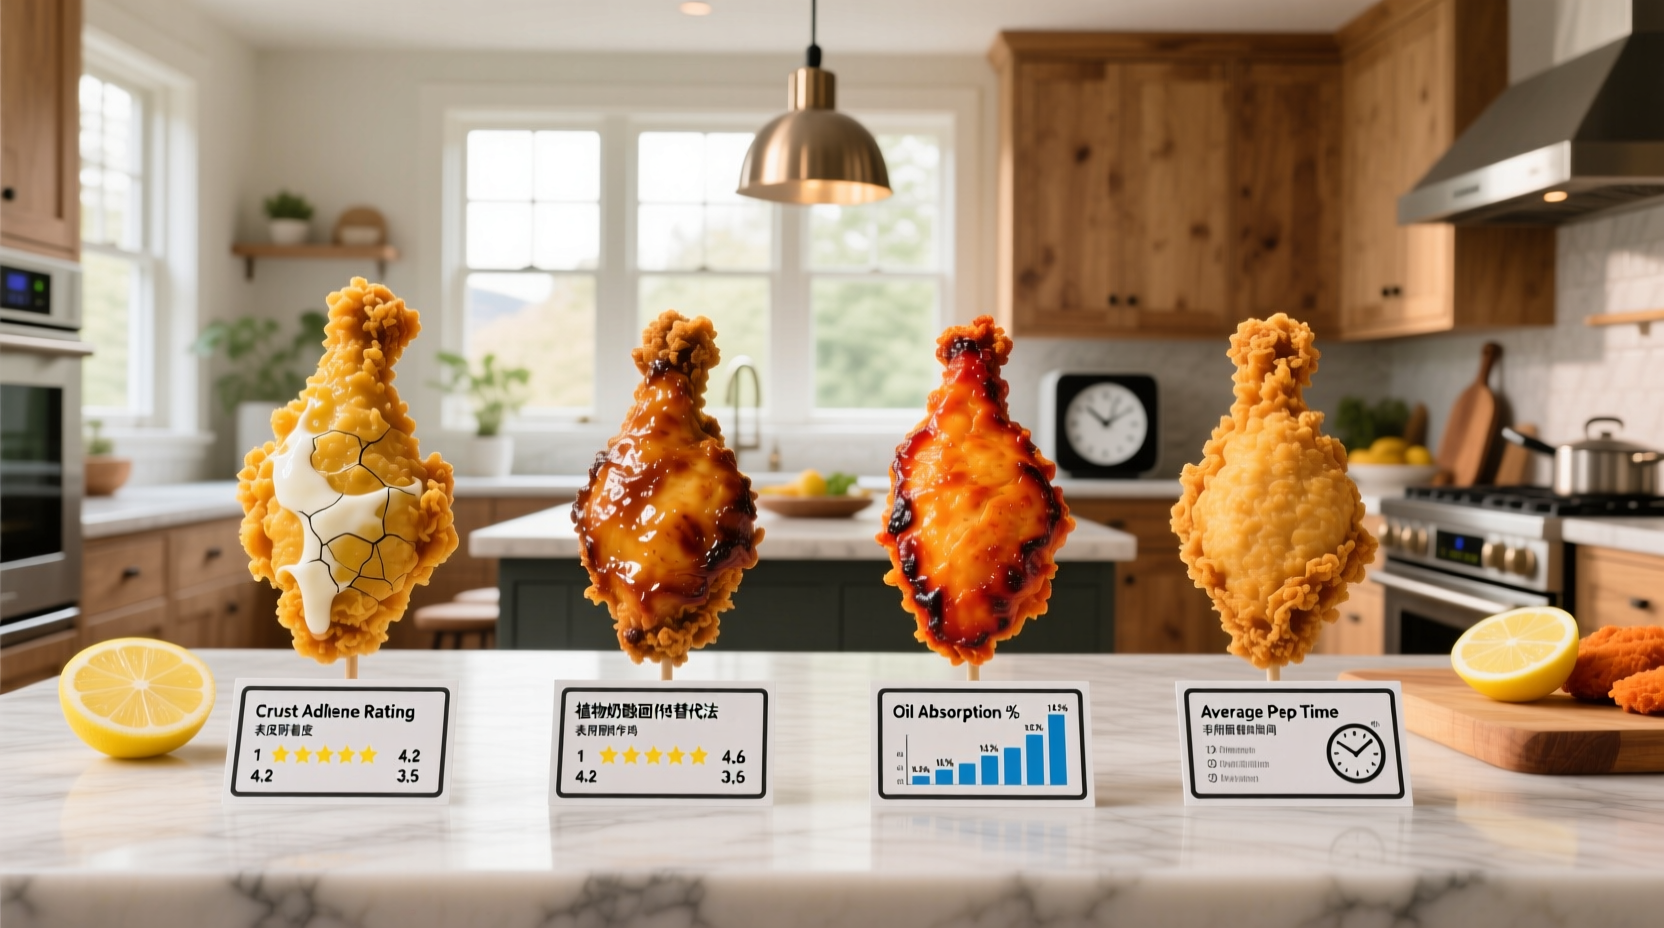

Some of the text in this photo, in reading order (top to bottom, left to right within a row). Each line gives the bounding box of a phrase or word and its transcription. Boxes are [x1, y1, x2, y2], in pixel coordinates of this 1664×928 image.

[255, 703, 299, 719] Crust
[364, 703, 415, 722] Rating
[893, 704, 1020, 723] Oil Absorption %
[1201, 704, 1339, 722] Average Pep Time
[254, 748, 261, 762] 1
[398, 749, 421, 763] 4.2
[577, 750, 584, 762] 1
[721, 749, 746, 764] 4.6
[250, 769, 274, 783] 4.2
[396, 769, 420, 783] 3.5
[575, 770, 597, 783] 4.2
